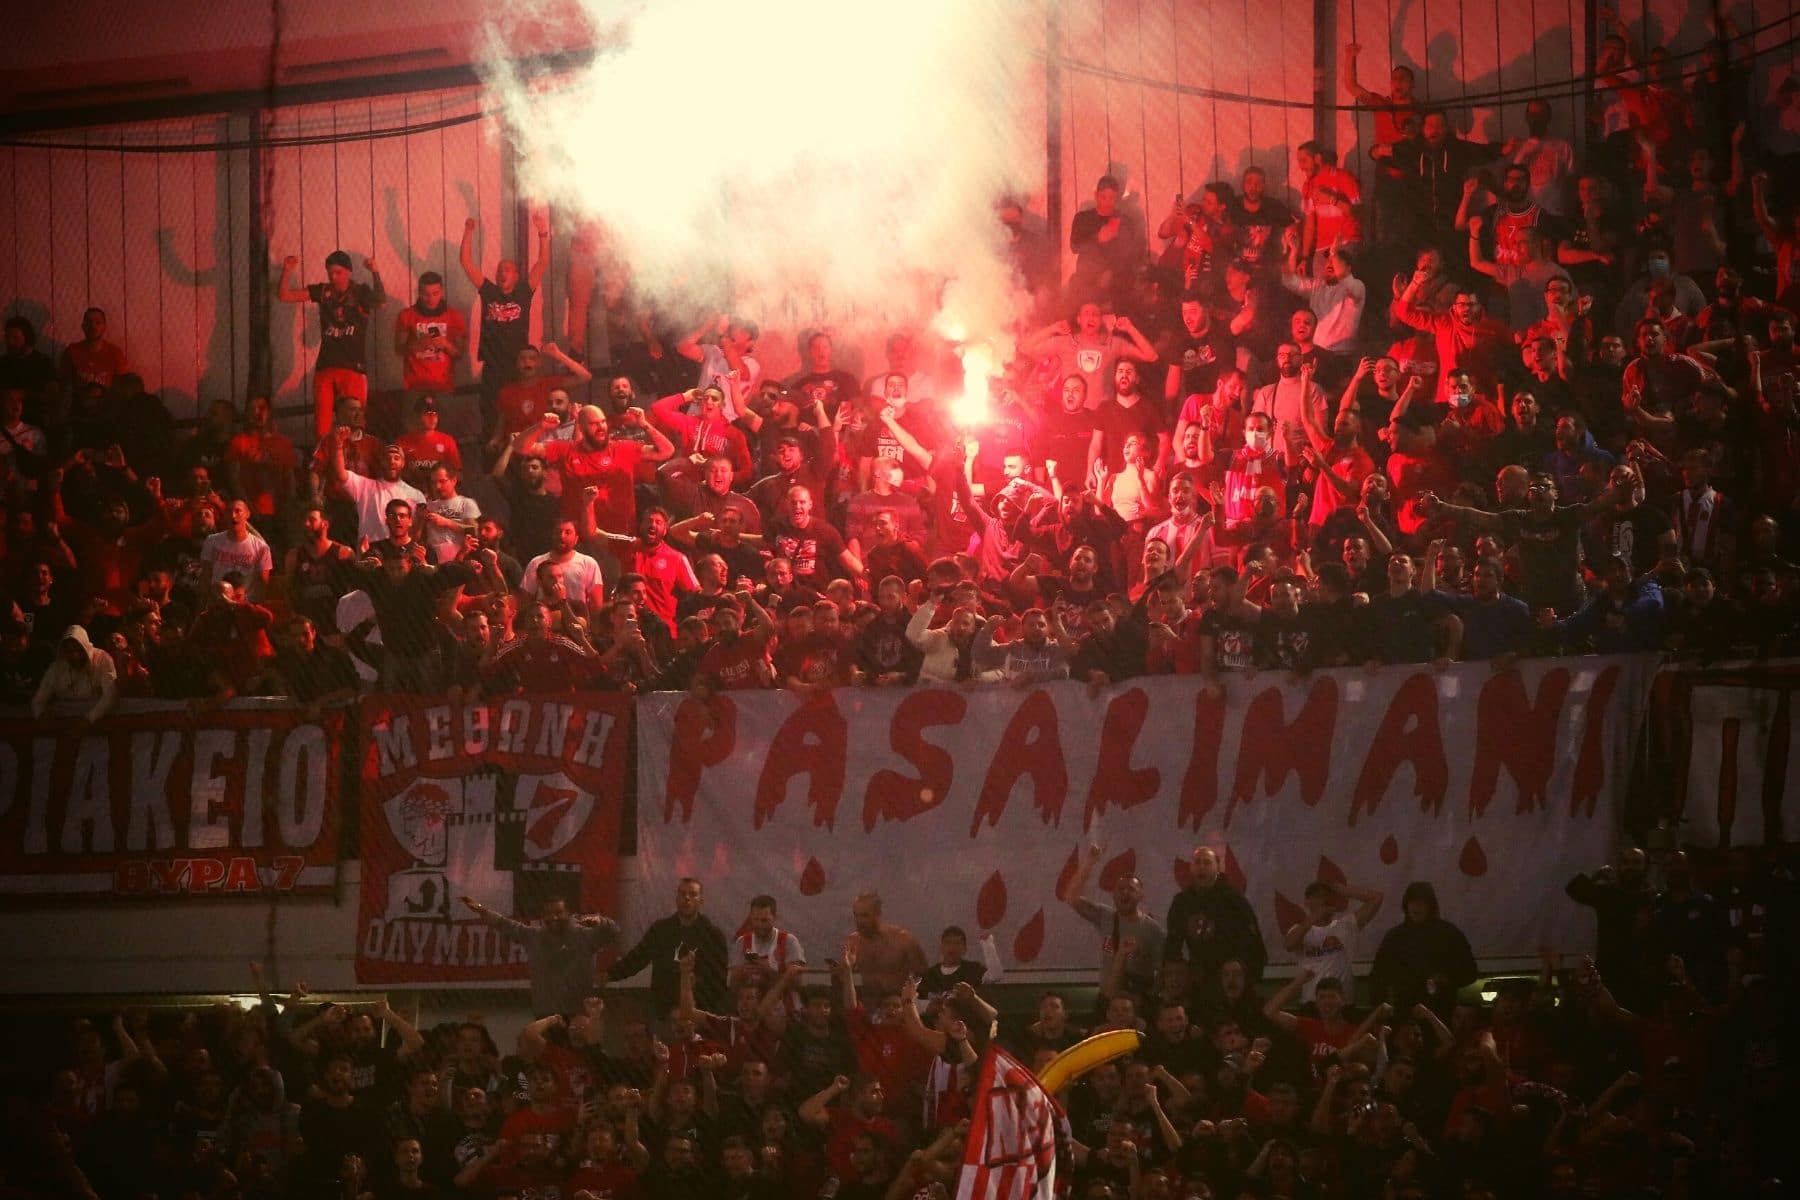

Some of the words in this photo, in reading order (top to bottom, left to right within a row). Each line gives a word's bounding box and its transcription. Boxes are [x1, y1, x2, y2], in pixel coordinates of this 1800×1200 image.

[371, 699, 617, 778] ΜΕΘΩΝΗ
[664, 665, 1621, 839] PASALIMANI
[113, 856, 263, 896] ΘΥΡΑ
[272, 855, 305, 891] 7
